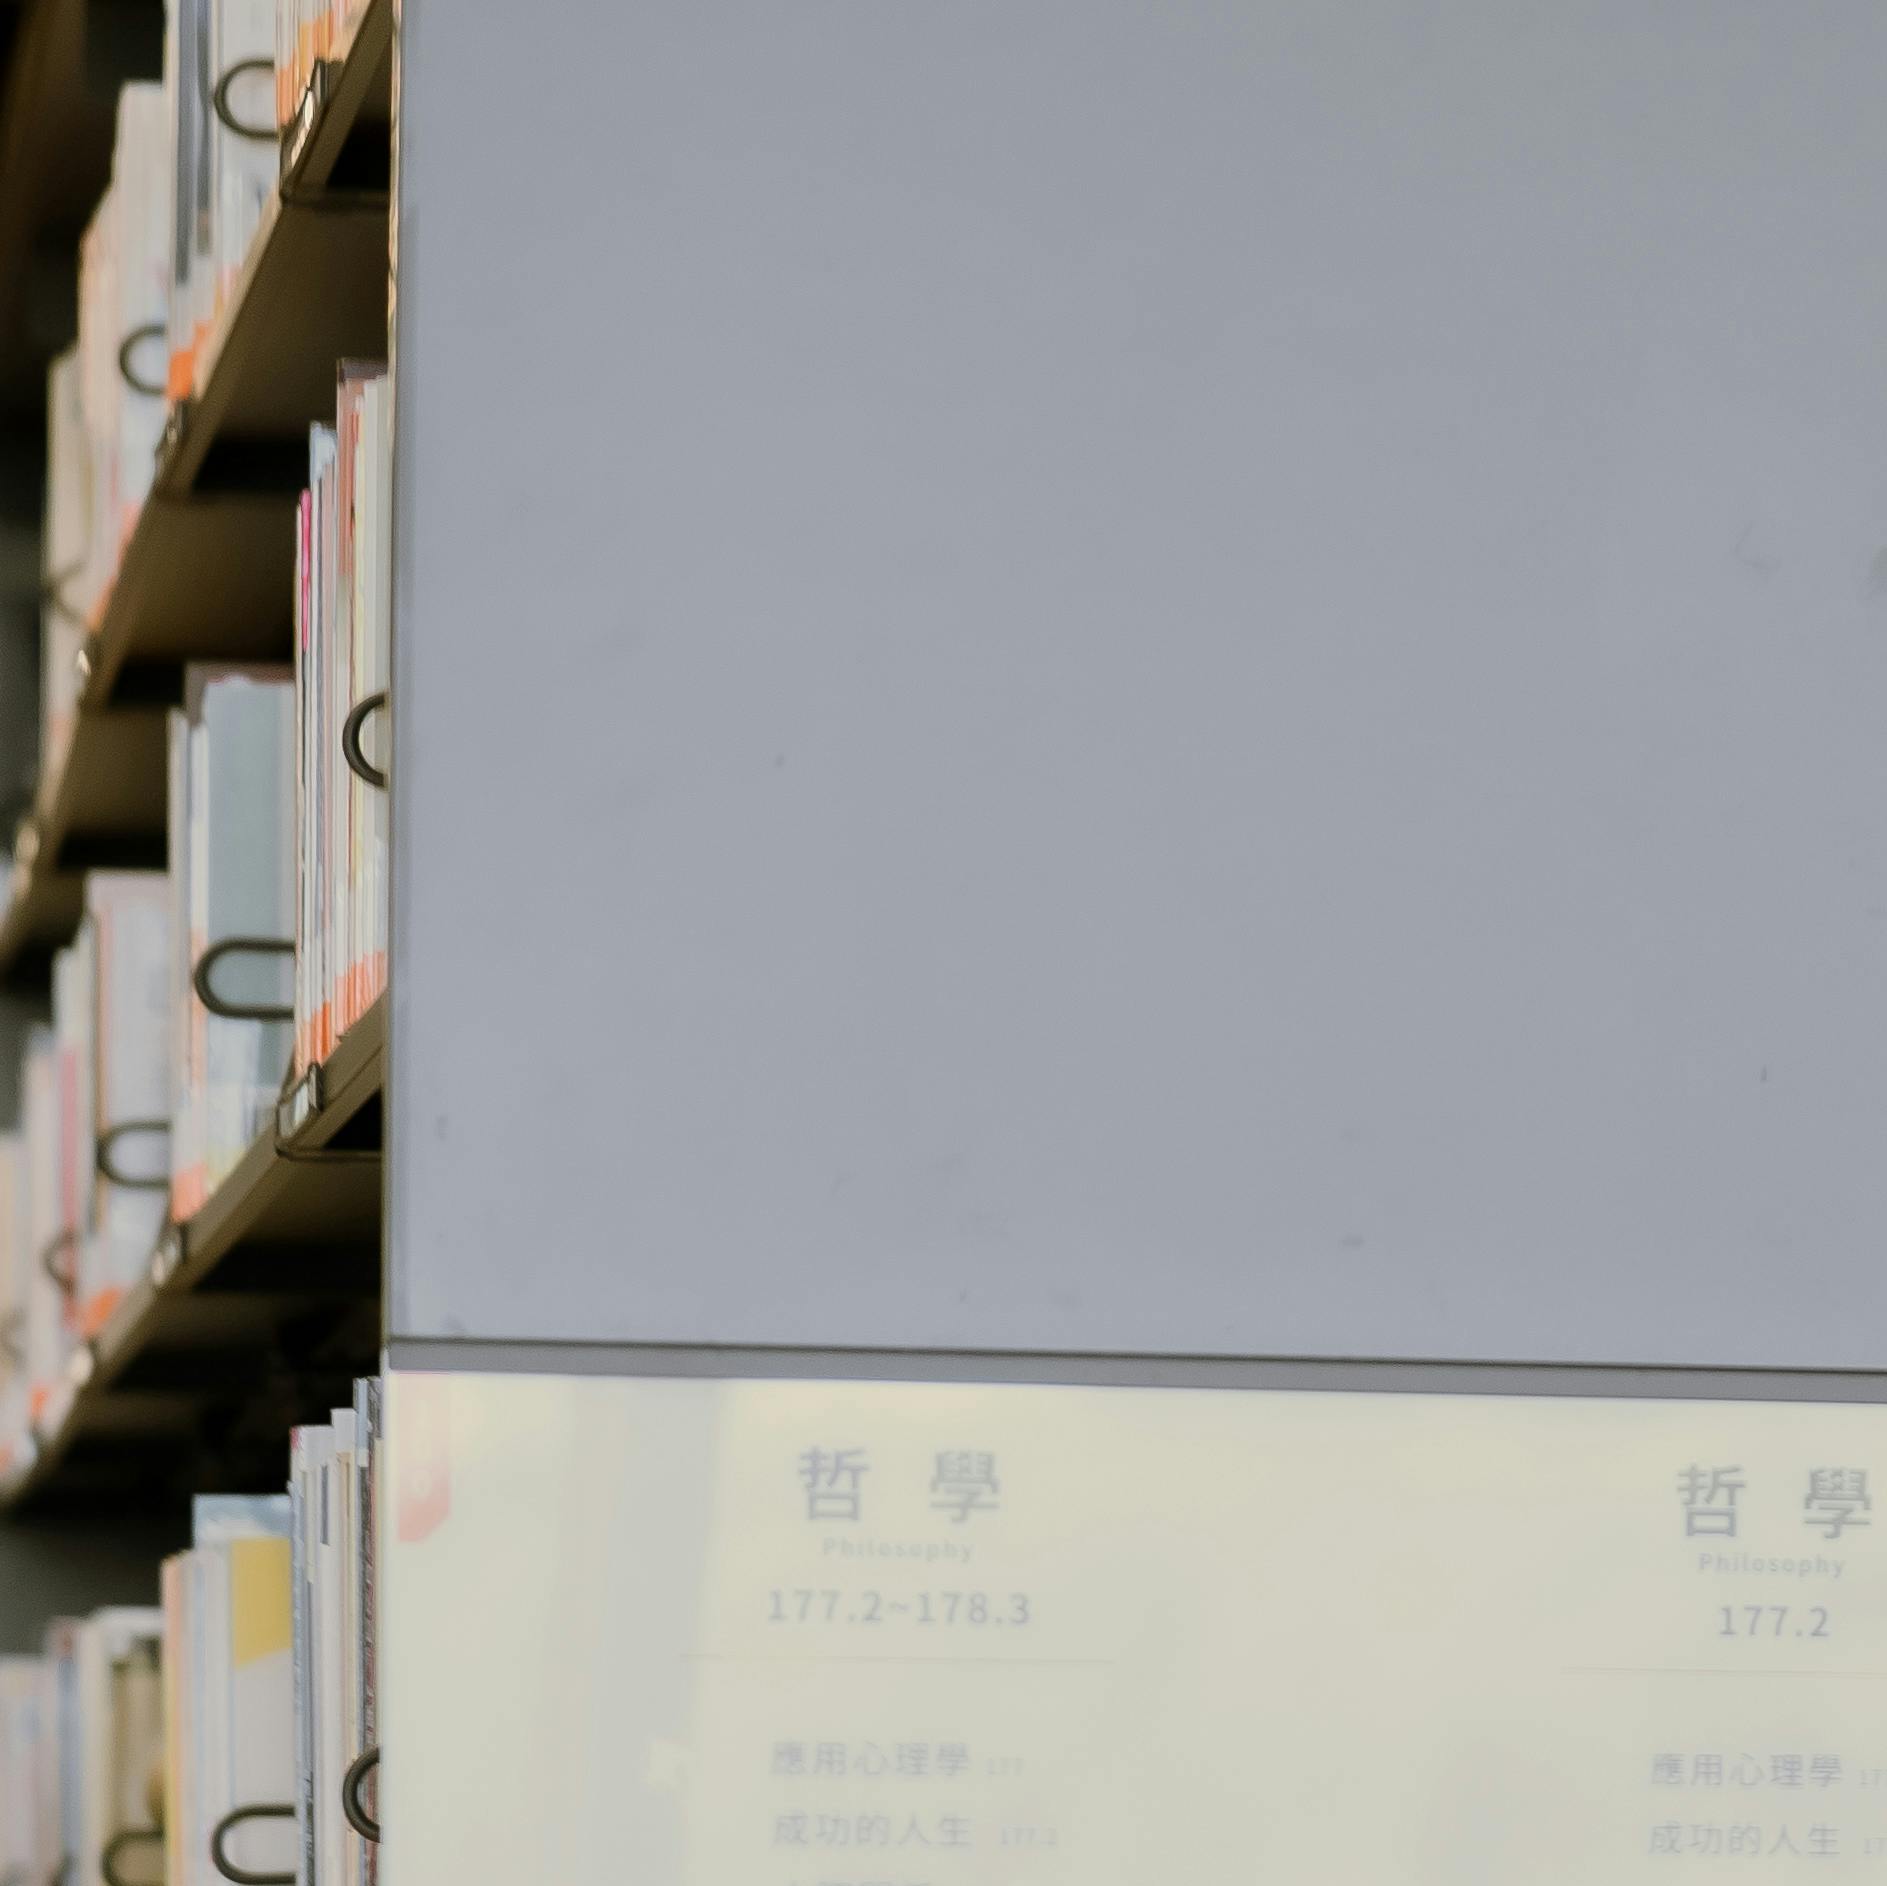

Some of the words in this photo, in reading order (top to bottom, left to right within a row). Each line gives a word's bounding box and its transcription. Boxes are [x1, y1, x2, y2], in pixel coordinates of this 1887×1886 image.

[822, 1537, 976, 1565] Philosophy
[1698, 1552, 1846, 1579] Philosophy
[766, 1588, 1032, 1626] 177.2~178.3
[1718, 1604, 1830, 1638] 177.2
[770, 1738, 972, 1778] 應用心理學
[1649, 1752, 1845, 1790] 應用心理學
[770, 1808, 975, 1848] 成功的人生
[1647, 1820, 1842, 1858] 成功的人生
